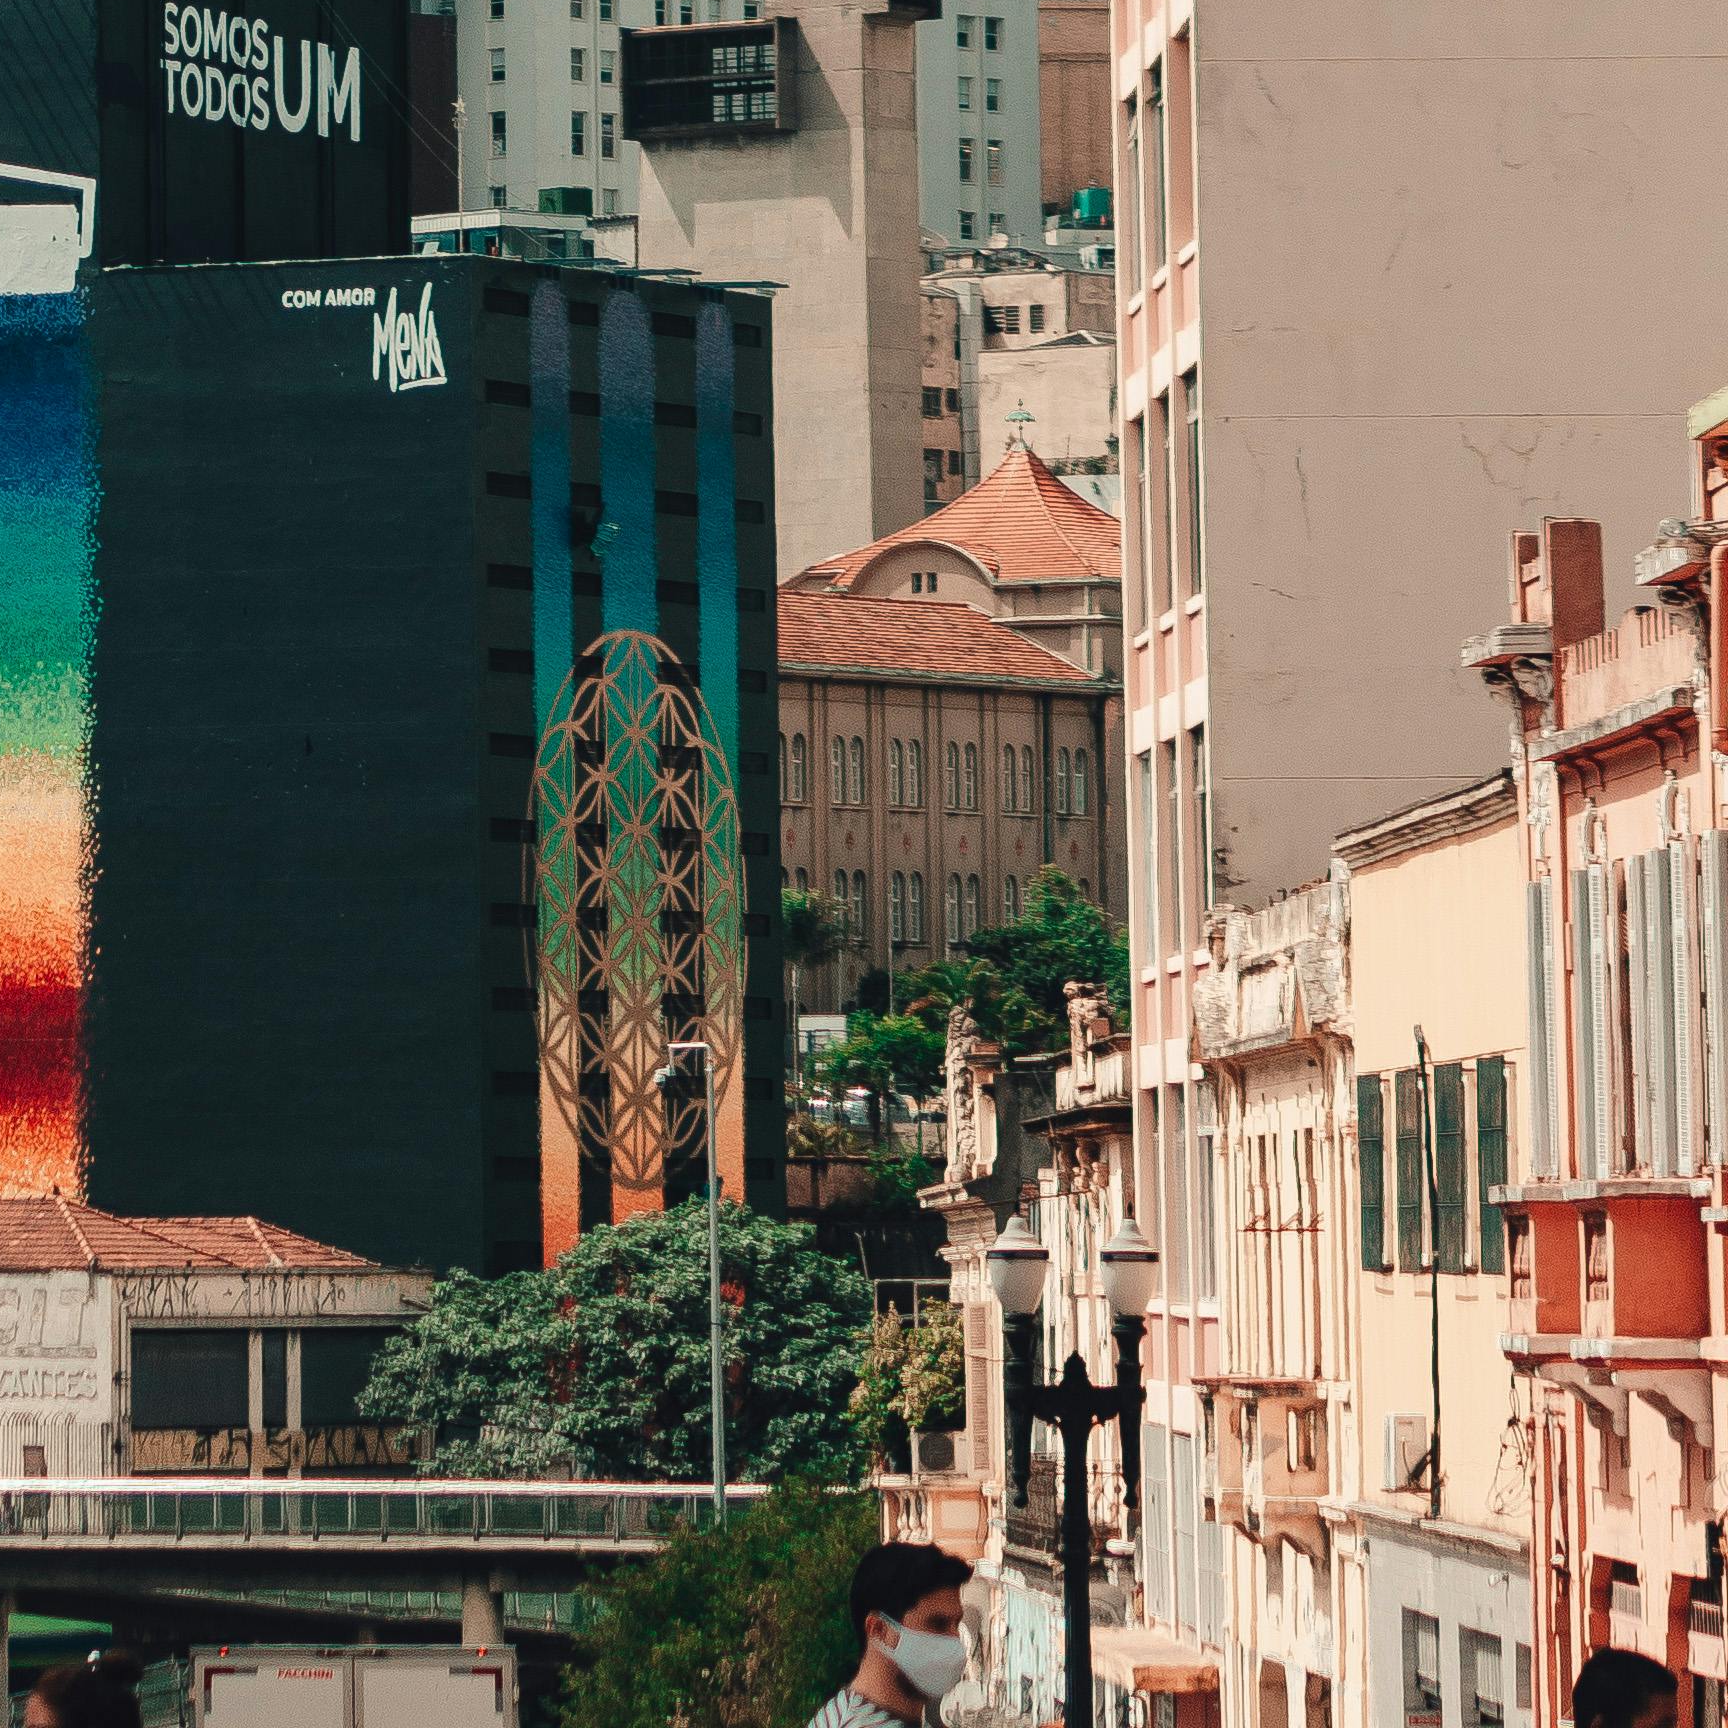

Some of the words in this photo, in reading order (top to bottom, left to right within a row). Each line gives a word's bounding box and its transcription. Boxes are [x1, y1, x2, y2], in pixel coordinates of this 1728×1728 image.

[165, 2, 269, 70] SOMOS
[160, 57, 270, 130] TODOS
[274, 36, 360, 141] UM
[281, 289, 322, 309] COM
[325, 287, 376, 307] AMOR
